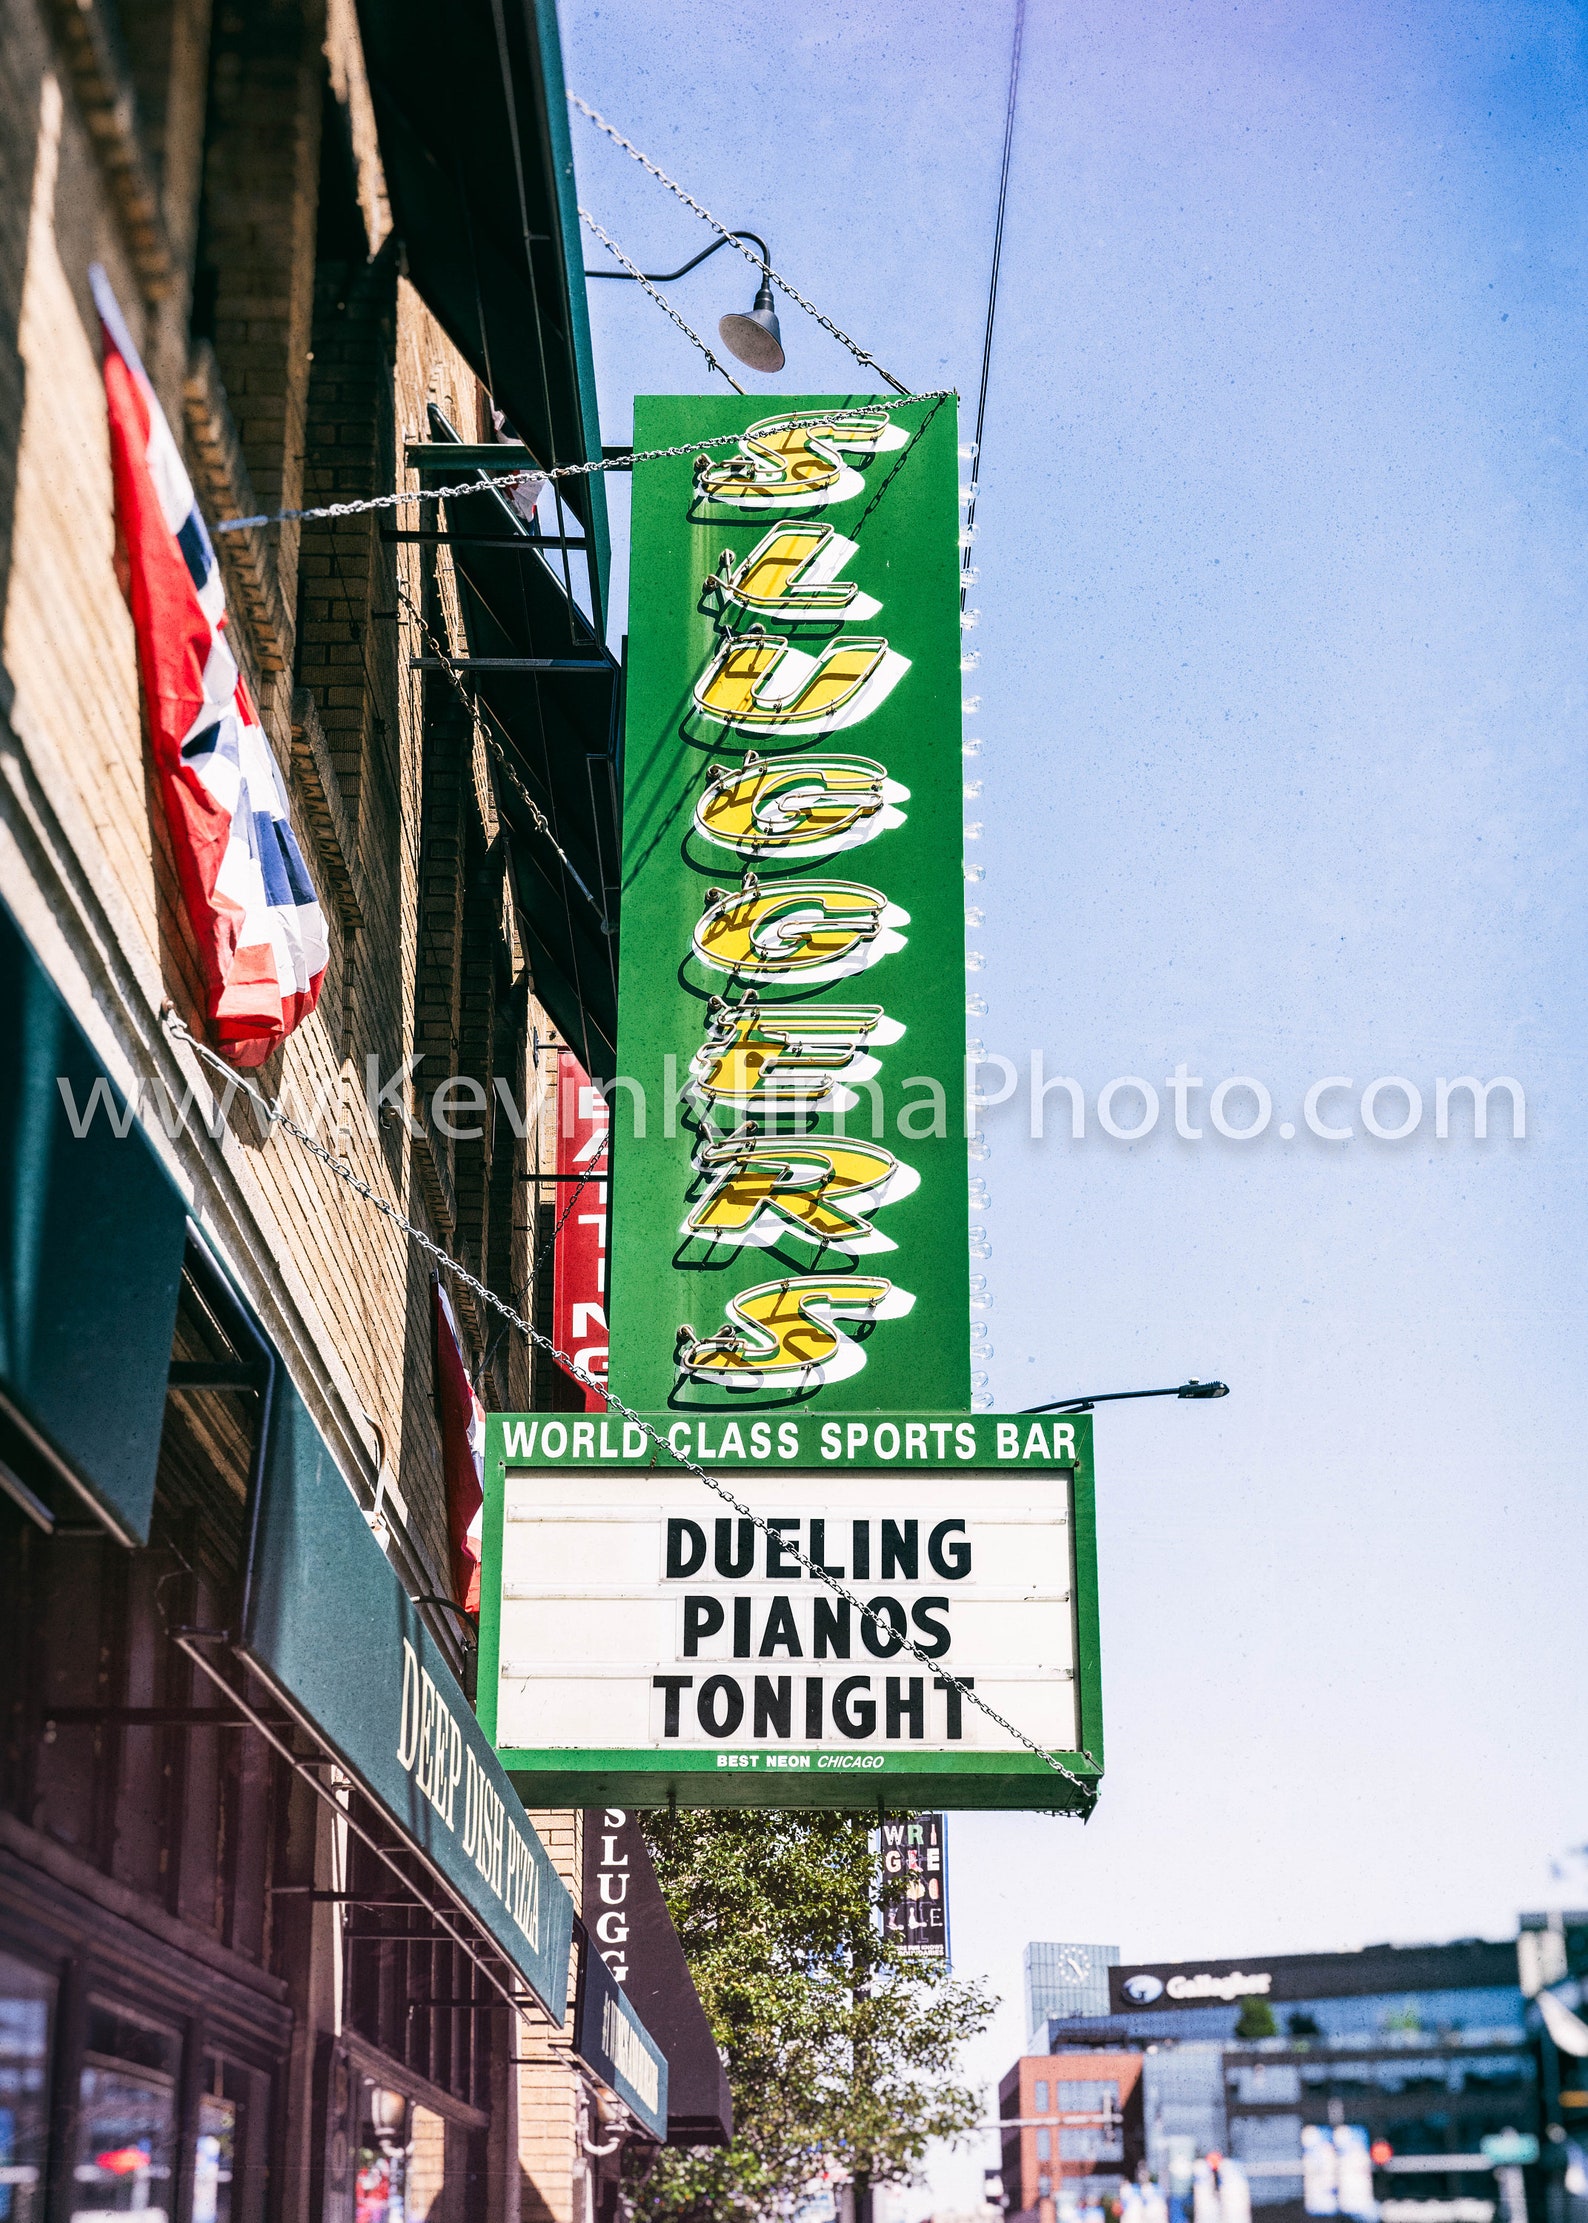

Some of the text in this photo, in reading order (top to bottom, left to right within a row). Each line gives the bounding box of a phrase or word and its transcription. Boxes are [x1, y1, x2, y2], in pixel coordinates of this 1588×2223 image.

[682, 409, 921, 1388] SLUGGERS
[502, 1421, 1076, 1460] WORLD CLASS SPORTS BAR
[666, 1518, 972, 1580] DUELING
[683, 1596, 951, 1659] PIANOS
[652, 1675, 974, 1739] TONIGHT
[716, 1755, 885, 1768] BEST NEON CHICAGO
[397, 1637, 540, 1955] DEEP DISH PIZZA
